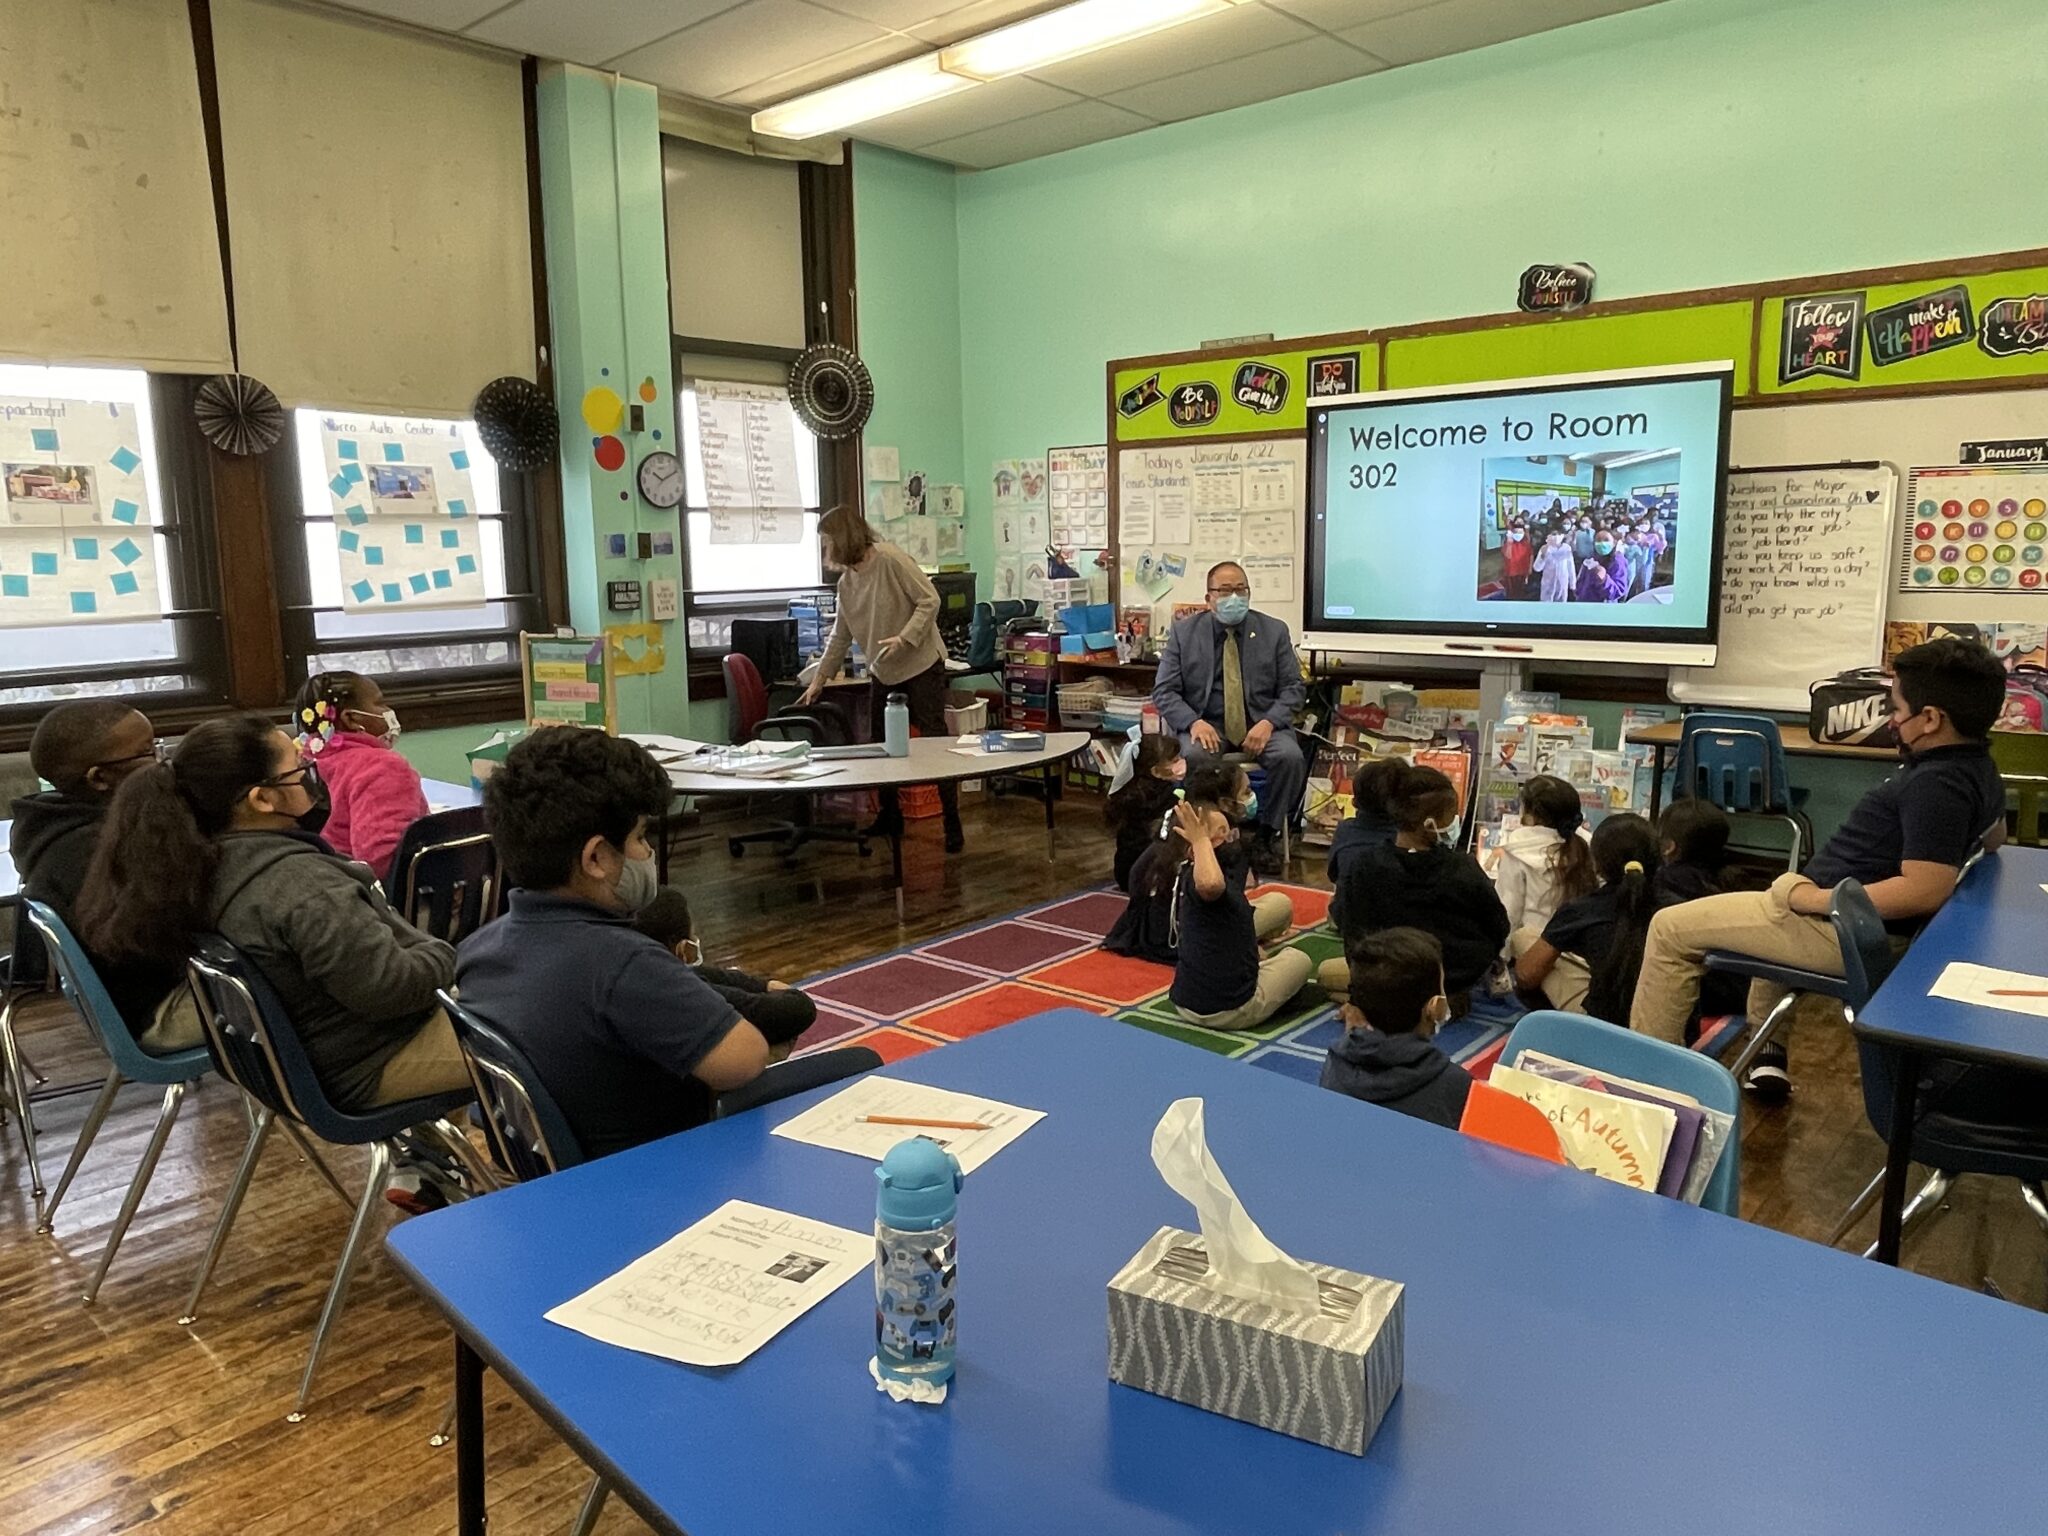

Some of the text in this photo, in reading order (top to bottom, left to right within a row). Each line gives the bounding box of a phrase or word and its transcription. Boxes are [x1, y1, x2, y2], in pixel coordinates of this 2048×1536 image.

[1796, 300, 1851, 328] Follow
[1909, 303, 1945, 326] make
[1879, 316, 1962, 356] Happen
[1793, 350, 1848, 367] HEART
[1322, 363, 1343, 377] DO
[1181, 386, 1204, 404] Be
[370, 421, 394, 434] Auto
[1349, 412, 1648, 451] Welcome to Room
[1976, 445, 2043, 462] January
[1143, 452, 1173, 473] Today
[1148, 474, 1190, 489] Standards
[1349, 462, 1397, 489] 302
[1786, 479, 1802, 492] for
[1814, 478, 1847, 494] Mayor
[1733, 511, 1747, 521] do
[1751, 513, 1768, 524] you
[1773, 508, 1794, 522] help
[1800, 508, 1815, 519] the
[1733, 524, 1747, 534] do
[1751, 526, 1768, 537] you
[1776, 524, 1790, 534] do
[1794, 525, 1814, 536] your
[1753, 536, 1771, 550] job
[1735, 551, 1748, 560] do
[1755, 552, 1771, 564] you
[1778, 549, 1803, 561] keep
[1809, 552, 1822, 560] us
[1725, 565, 1742, 577] you
[1749, 563, 1774, 574] work
[1730, 577, 1743, 588] do
[1750, 580, 1768, 591] you
[1773, 576, 1799, 587] know
[1807, 576, 1829, 588] what
[1834, 579, 1846, 588] is
[2023, 574, 2038, 584] 27
[1724, 603, 1742, 614] did
[1747, 606, 1765, 618] you
[1770, 603, 1787, 619] get
[1792, 606, 1815, 619] your
[1827, 693, 1888, 736] NIKE
[1318, 749, 1357, 762] Perfect
[1548, 1104, 1568, 1123] of
[1572, 1106, 1645, 1189] Autumn
